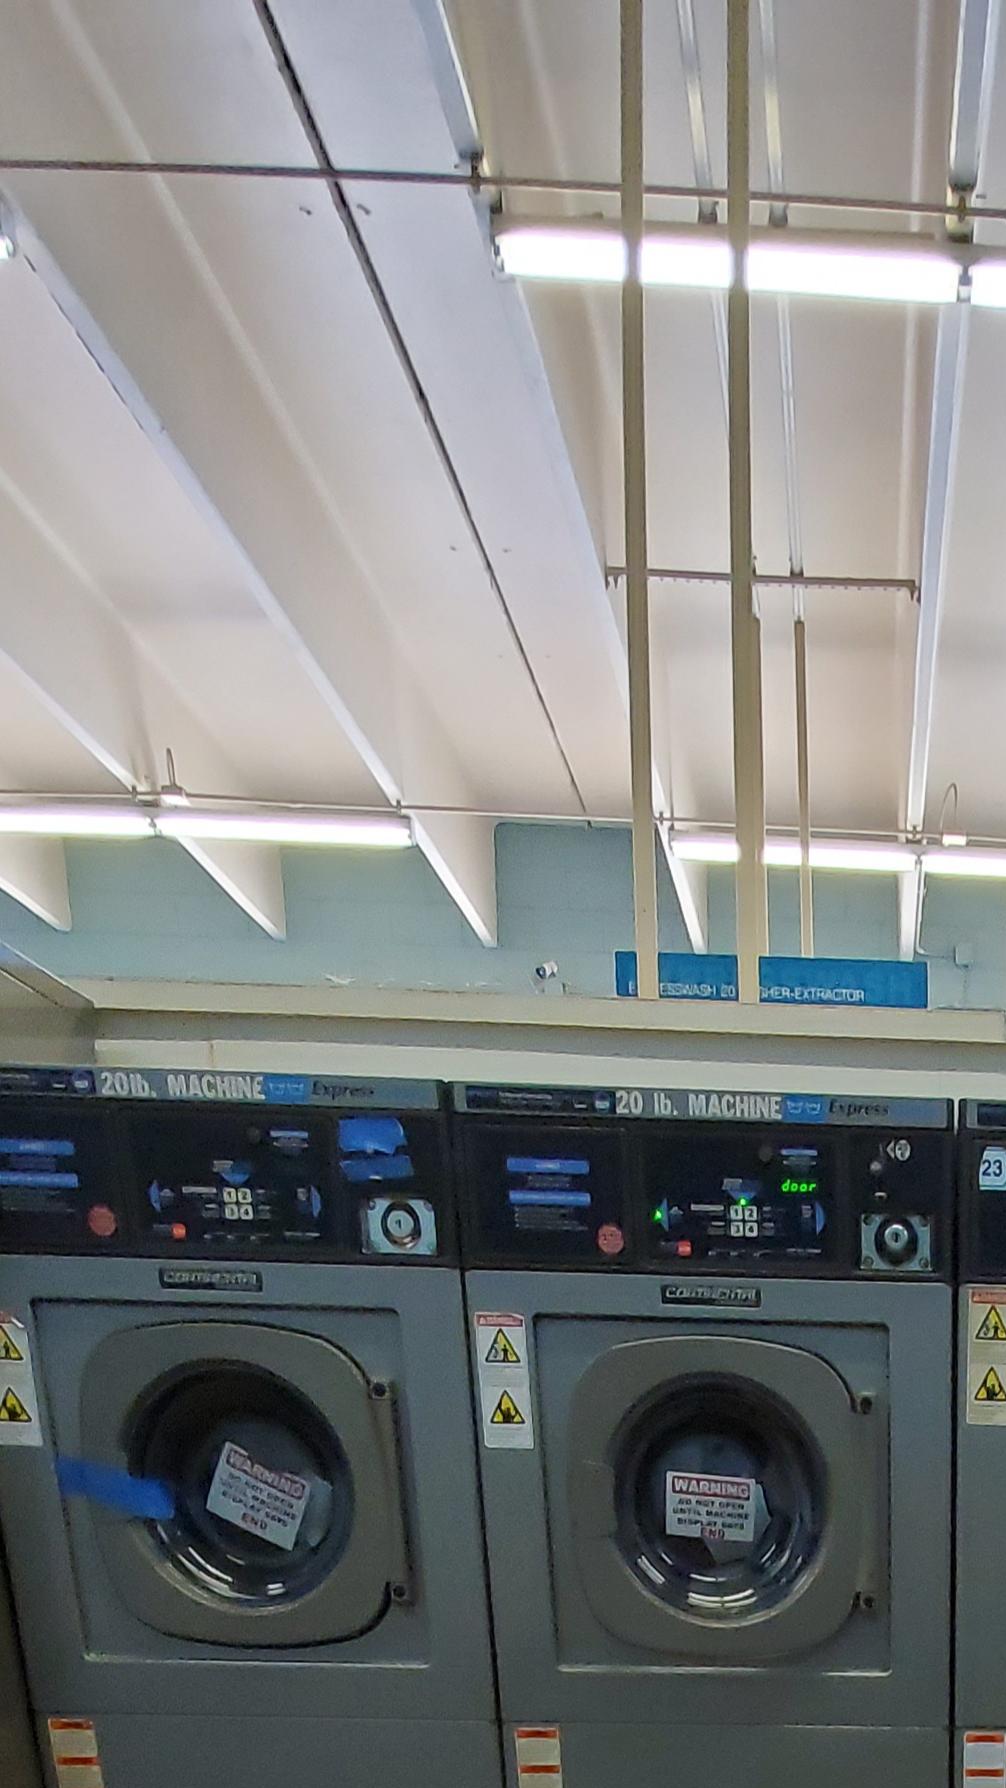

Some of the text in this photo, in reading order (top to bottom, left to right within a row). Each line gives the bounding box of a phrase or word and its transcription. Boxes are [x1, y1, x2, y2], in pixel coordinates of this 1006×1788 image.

[166, 1073, 266, 1100] MACHINE
[615, 1090, 643, 1115] 20
[687, 1093, 783, 1120] MACHINE
[828, 1099, 891, 1118] Express
[981, 1159, 1003, 1178] 23
[780, 1178, 817, 1193] door
[673, 1477, 749, 1498] WARNING
